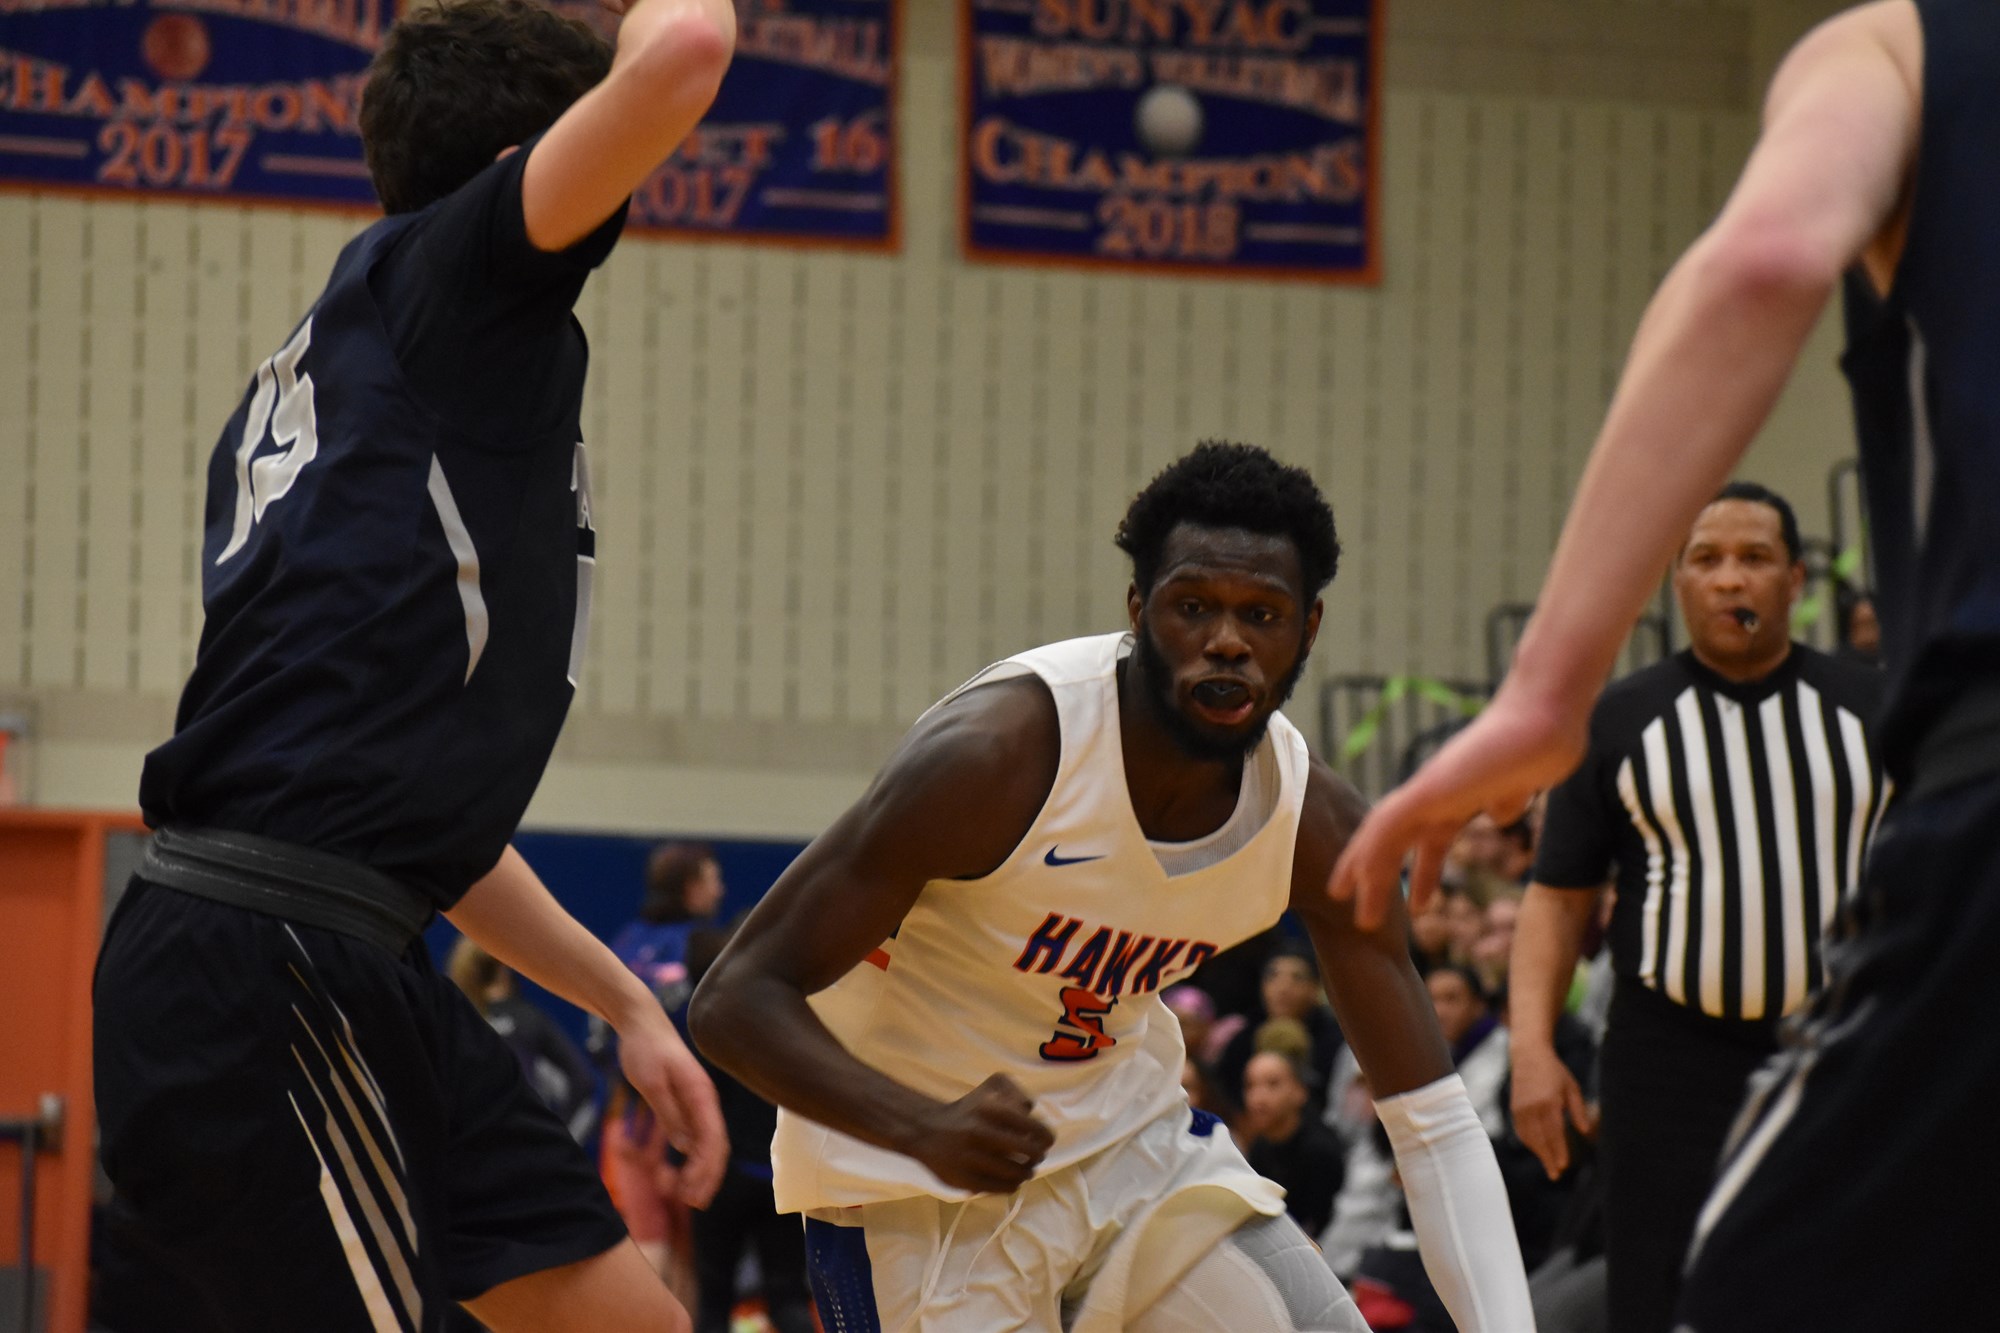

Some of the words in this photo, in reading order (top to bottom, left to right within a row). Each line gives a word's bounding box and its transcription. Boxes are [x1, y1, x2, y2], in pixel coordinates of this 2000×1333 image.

[1033, 0, 1312, 50] SUNYAC
[97, 120, 254, 187] 2017
[973, 118, 1361, 202] CHAMPIONS
[1039, 986, 1119, 1061] 5
